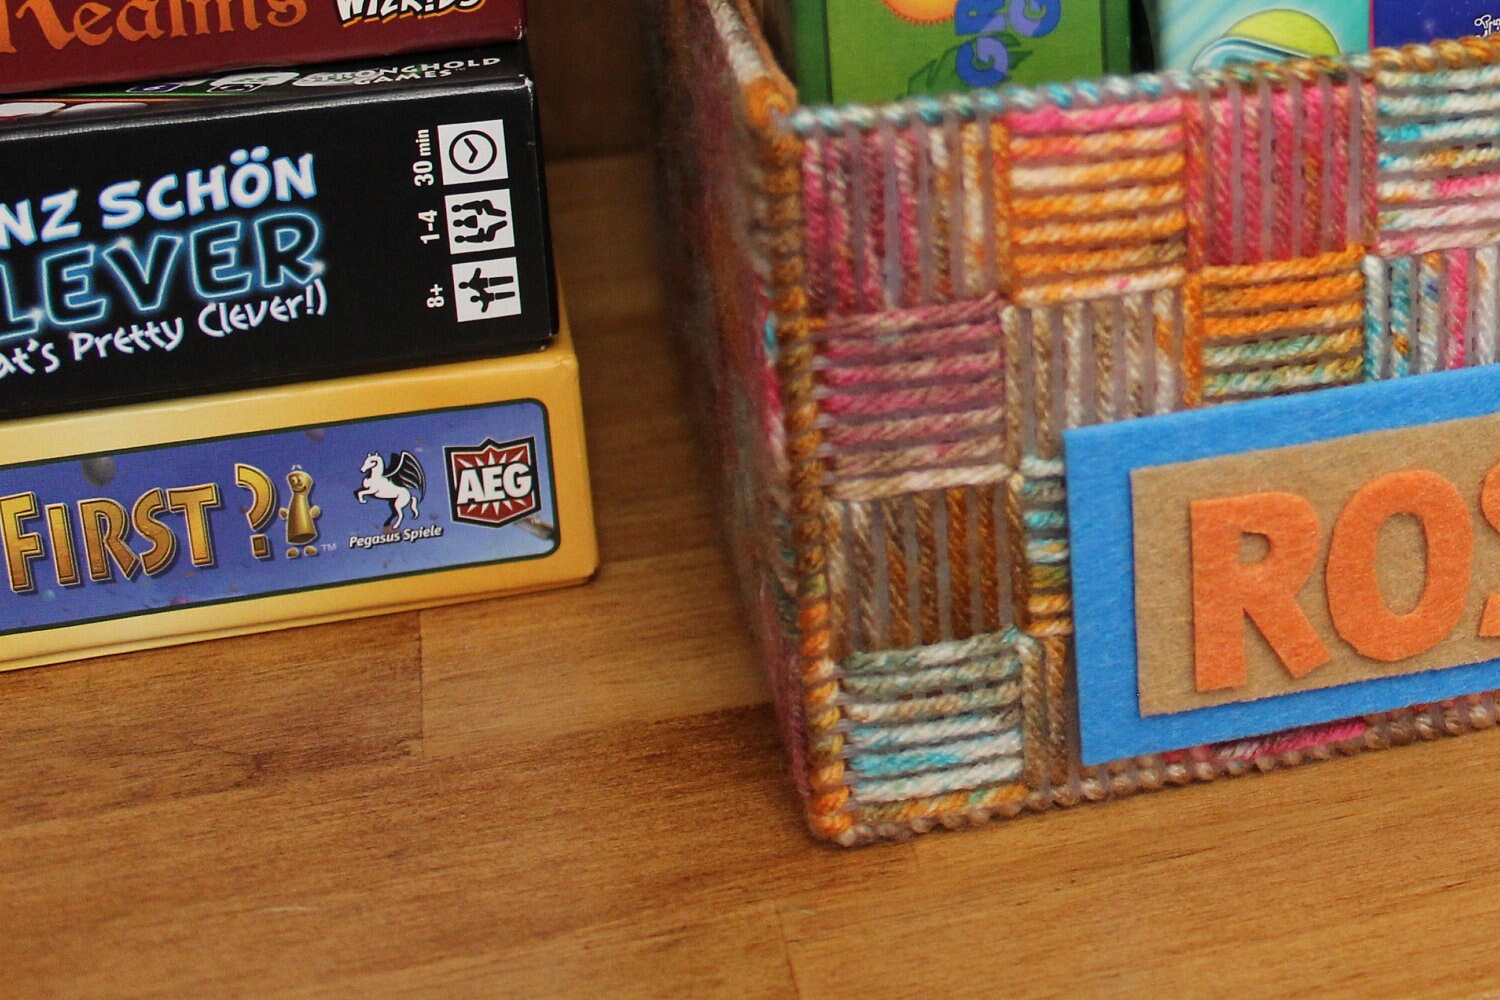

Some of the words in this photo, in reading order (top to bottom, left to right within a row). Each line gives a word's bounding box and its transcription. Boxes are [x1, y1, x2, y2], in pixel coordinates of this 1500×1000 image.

[353, 68, 453, 86] GAMES
[415, 128, 429, 157] min
[100, 145, 318, 230] SCHÖN
[413, 160, 435, 187] 30
[420, 209, 441, 245] 1-4
[426, 282, 445, 309] 8+
[72, 315, 184, 362] Pretty
[198, 279, 329, 339] Clever!)
[457, 462, 533, 505] AEG
[349, 531, 401, 549] Pegasus
[402, 525, 443, 544] Spiele
